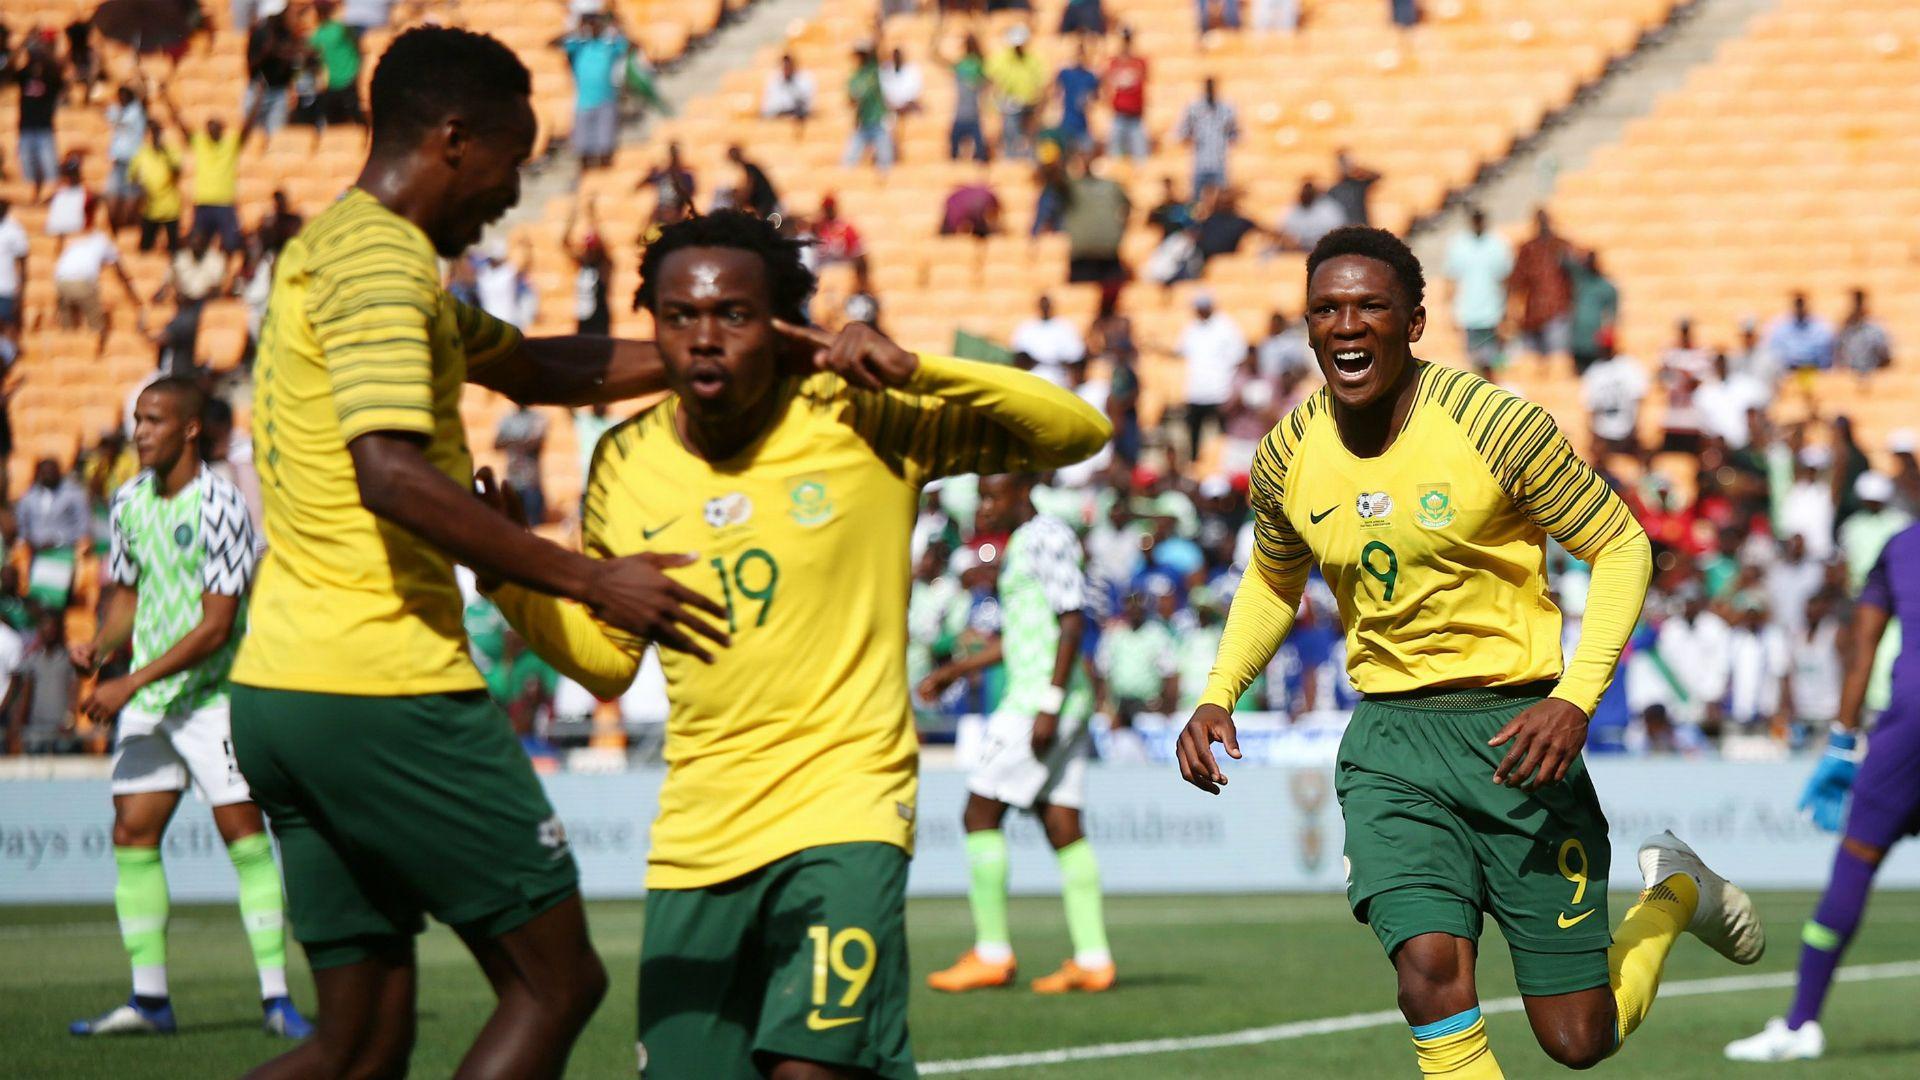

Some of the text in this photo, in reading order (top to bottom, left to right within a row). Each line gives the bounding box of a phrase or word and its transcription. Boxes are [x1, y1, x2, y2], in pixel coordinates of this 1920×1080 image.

[711, 548, 778, 633] 19
[1361, 541, 1398, 601] 9
[0, 818, 68, 871] ays
[1086, 801, 1226, 848] hildren
[1558, 838, 1588, 904] 9
[807, 925, 877, 1007] 19
